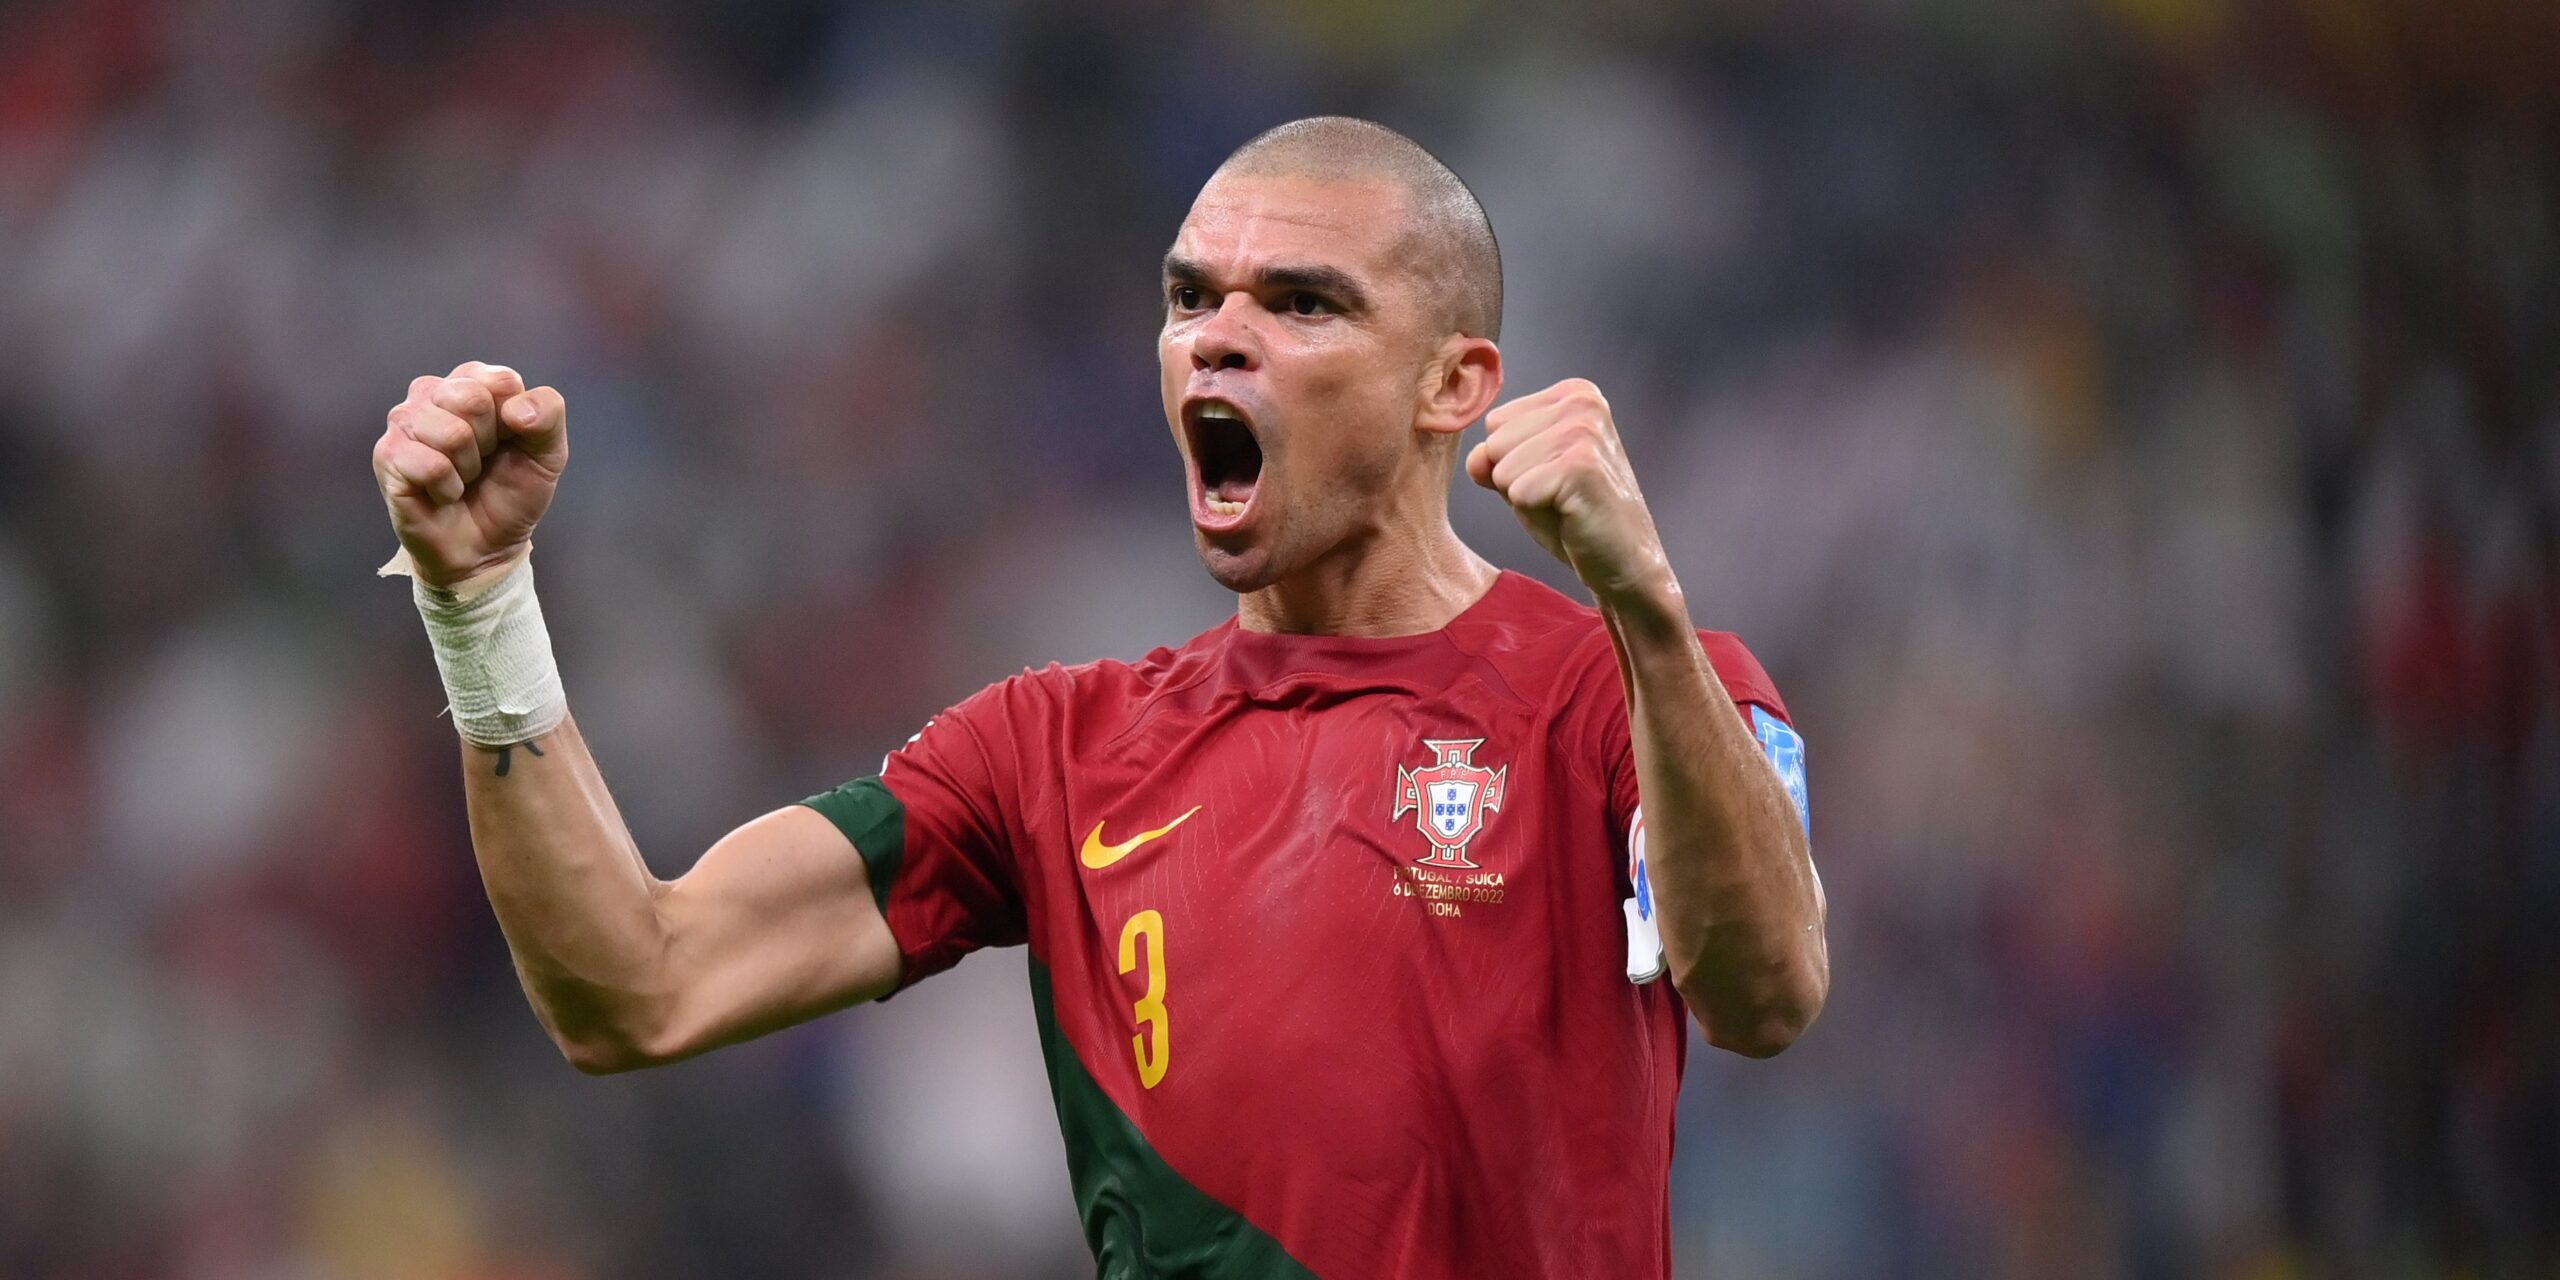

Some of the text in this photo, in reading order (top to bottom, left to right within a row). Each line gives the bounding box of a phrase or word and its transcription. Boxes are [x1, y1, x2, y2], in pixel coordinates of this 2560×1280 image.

[1393, 866, 1452, 883] PTUGAL
[1393, 881, 1402, 896] 6
[1416, 883, 1471, 902] EZEMBRO
[1472, 887, 1505, 904] 2022
[1427, 902, 1462, 918] DOHA
[1118, 909, 1170, 1090] 3
